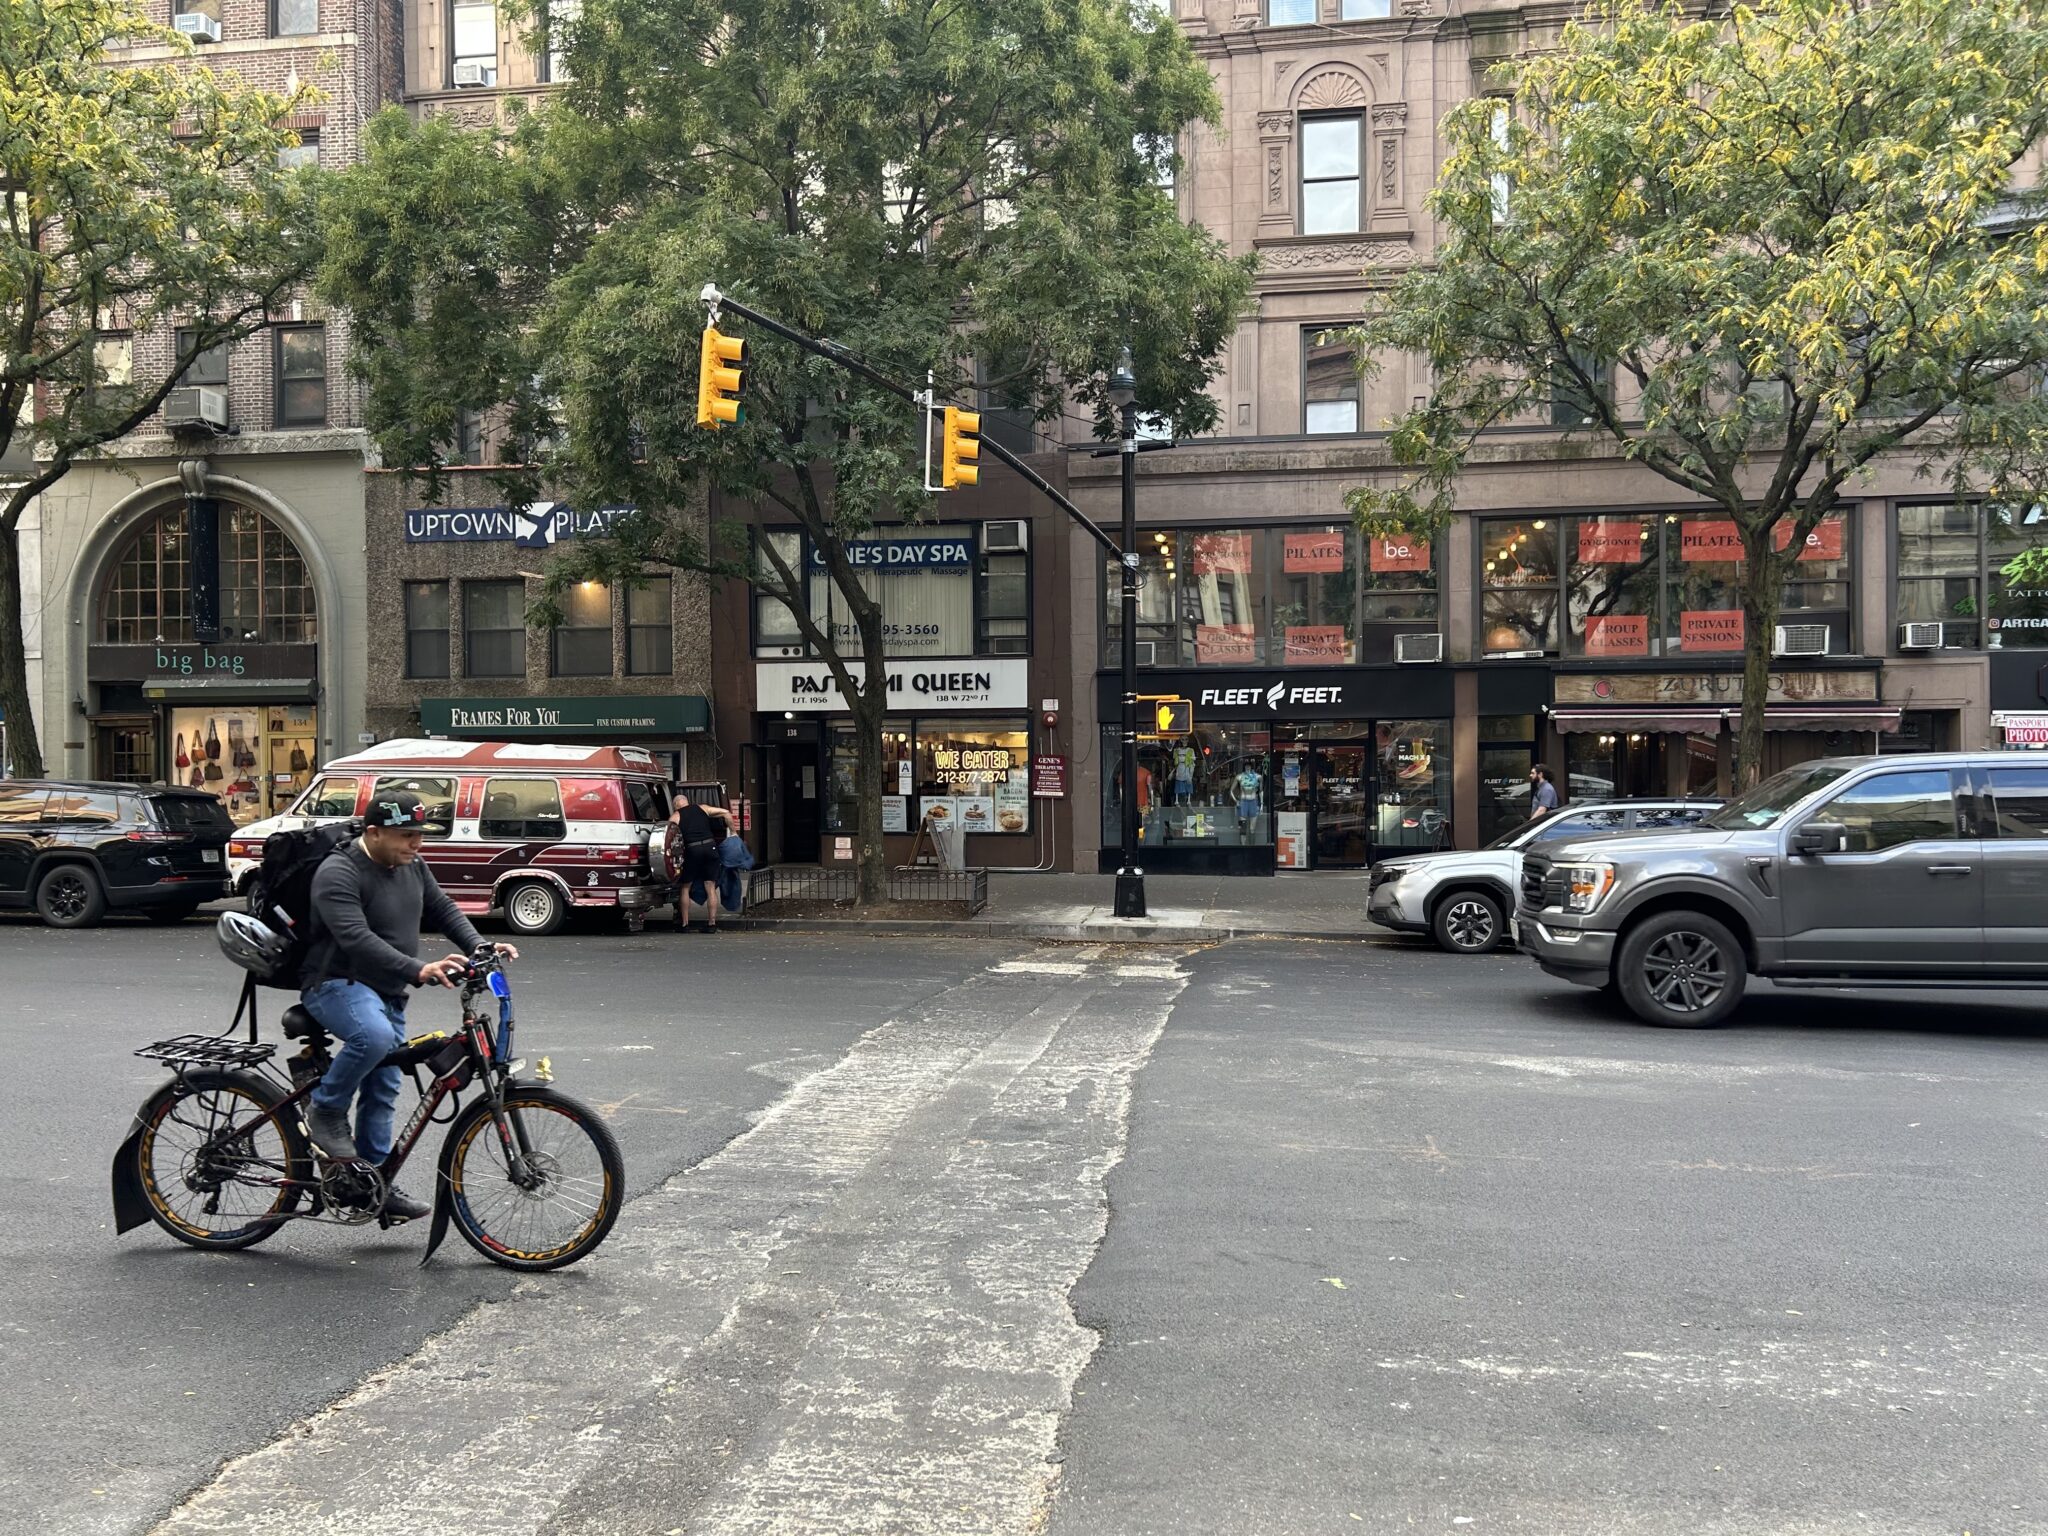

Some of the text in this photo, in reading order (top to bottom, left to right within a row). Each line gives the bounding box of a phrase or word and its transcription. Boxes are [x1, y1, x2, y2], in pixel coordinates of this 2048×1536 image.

[409, 512, 513, 537] UPTOWN
[1683, 535, 1743, 547] PILATES
[1806, 533, 1821, 546] e.
[813, 544, 968, 565] GNE'S DAY SPA
[1286, 547, 1342, 559] PILATES
[1385, 540, 1413, 559] be.
[873, 567, 922, 577] Therapeutic
[931, 567, 968, 577] Massage
[1597, 624, 1638, 634] GROUP
[1688, 619, 1738, 629] PRIVATE
[1292, 634, 1339, 644] PRIVATE
[1591, 637, 1644, 648] CLASSES
[1684, 632, 1742, 643] SESSIONS
[1202, 645, 1251, 655] CLASSES
[1289, 647, 1342, 656] SESSIONS
[156, 648, 245, 675] big bag
[792, 673, 991, 694] PASTRMI QUEEN
[1663, 677, 1784, 692] ZURUTO
[1201, 687, 1342, 706] FLEET FEET.
[293, 718, 307, 726] 134
[451, 708, 502, 726] FRAMES
[506, 707, 532, 725] FOR
[596, 718, 609, 727] FINE
[610, 718, 631, 727] CUSTOM
[631, 718, 656, 727] FRAMING
[2009, 719, 2046, 727] PASSPORT
[786, 729, 797, 737] 138
[2008, 729, 2048, 742] PHOTO
[935, 750, 1009, 769] WE CATER
[901, 763, 910, 773] A
[936, 770, 1007, 784] 212-877-2874
